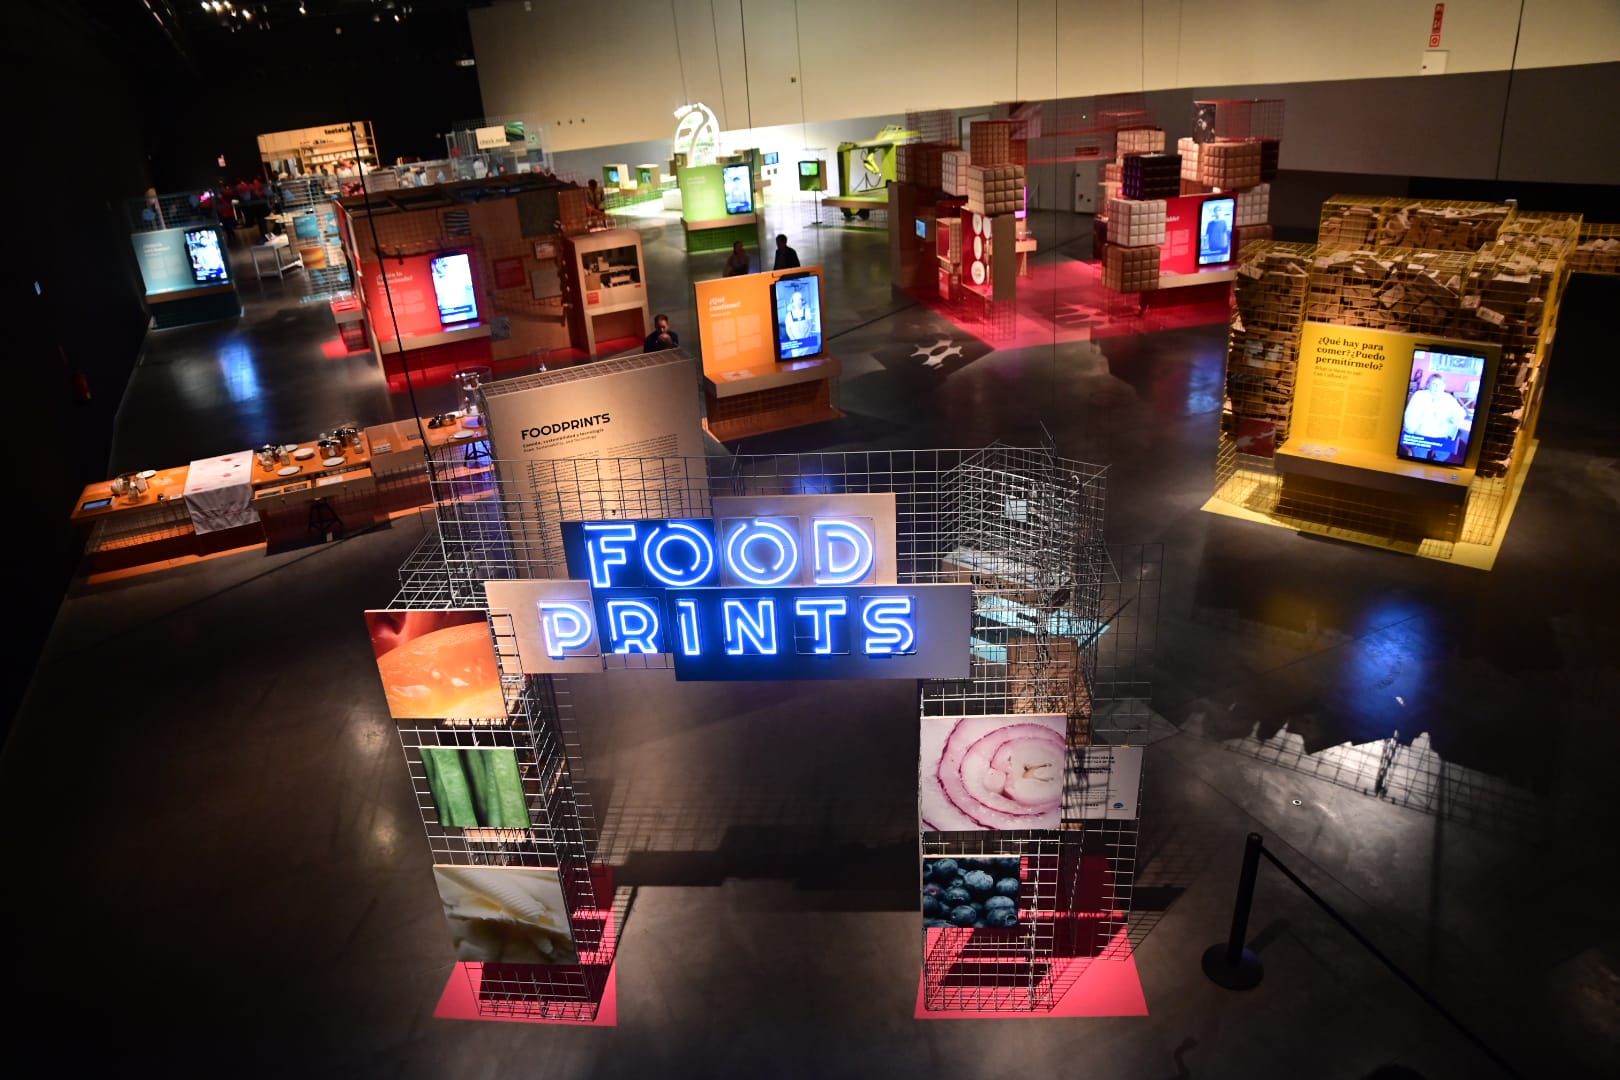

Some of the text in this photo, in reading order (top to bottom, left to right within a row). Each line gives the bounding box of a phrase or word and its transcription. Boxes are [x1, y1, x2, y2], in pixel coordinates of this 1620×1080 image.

[1317, 336, 1384, 351] ¿Qué hay para
[521, 412, 611, 441] FOODPRINTS
[583, 520, 874, 588] FOOD
[537, 598, 915, 658] PRINTS
